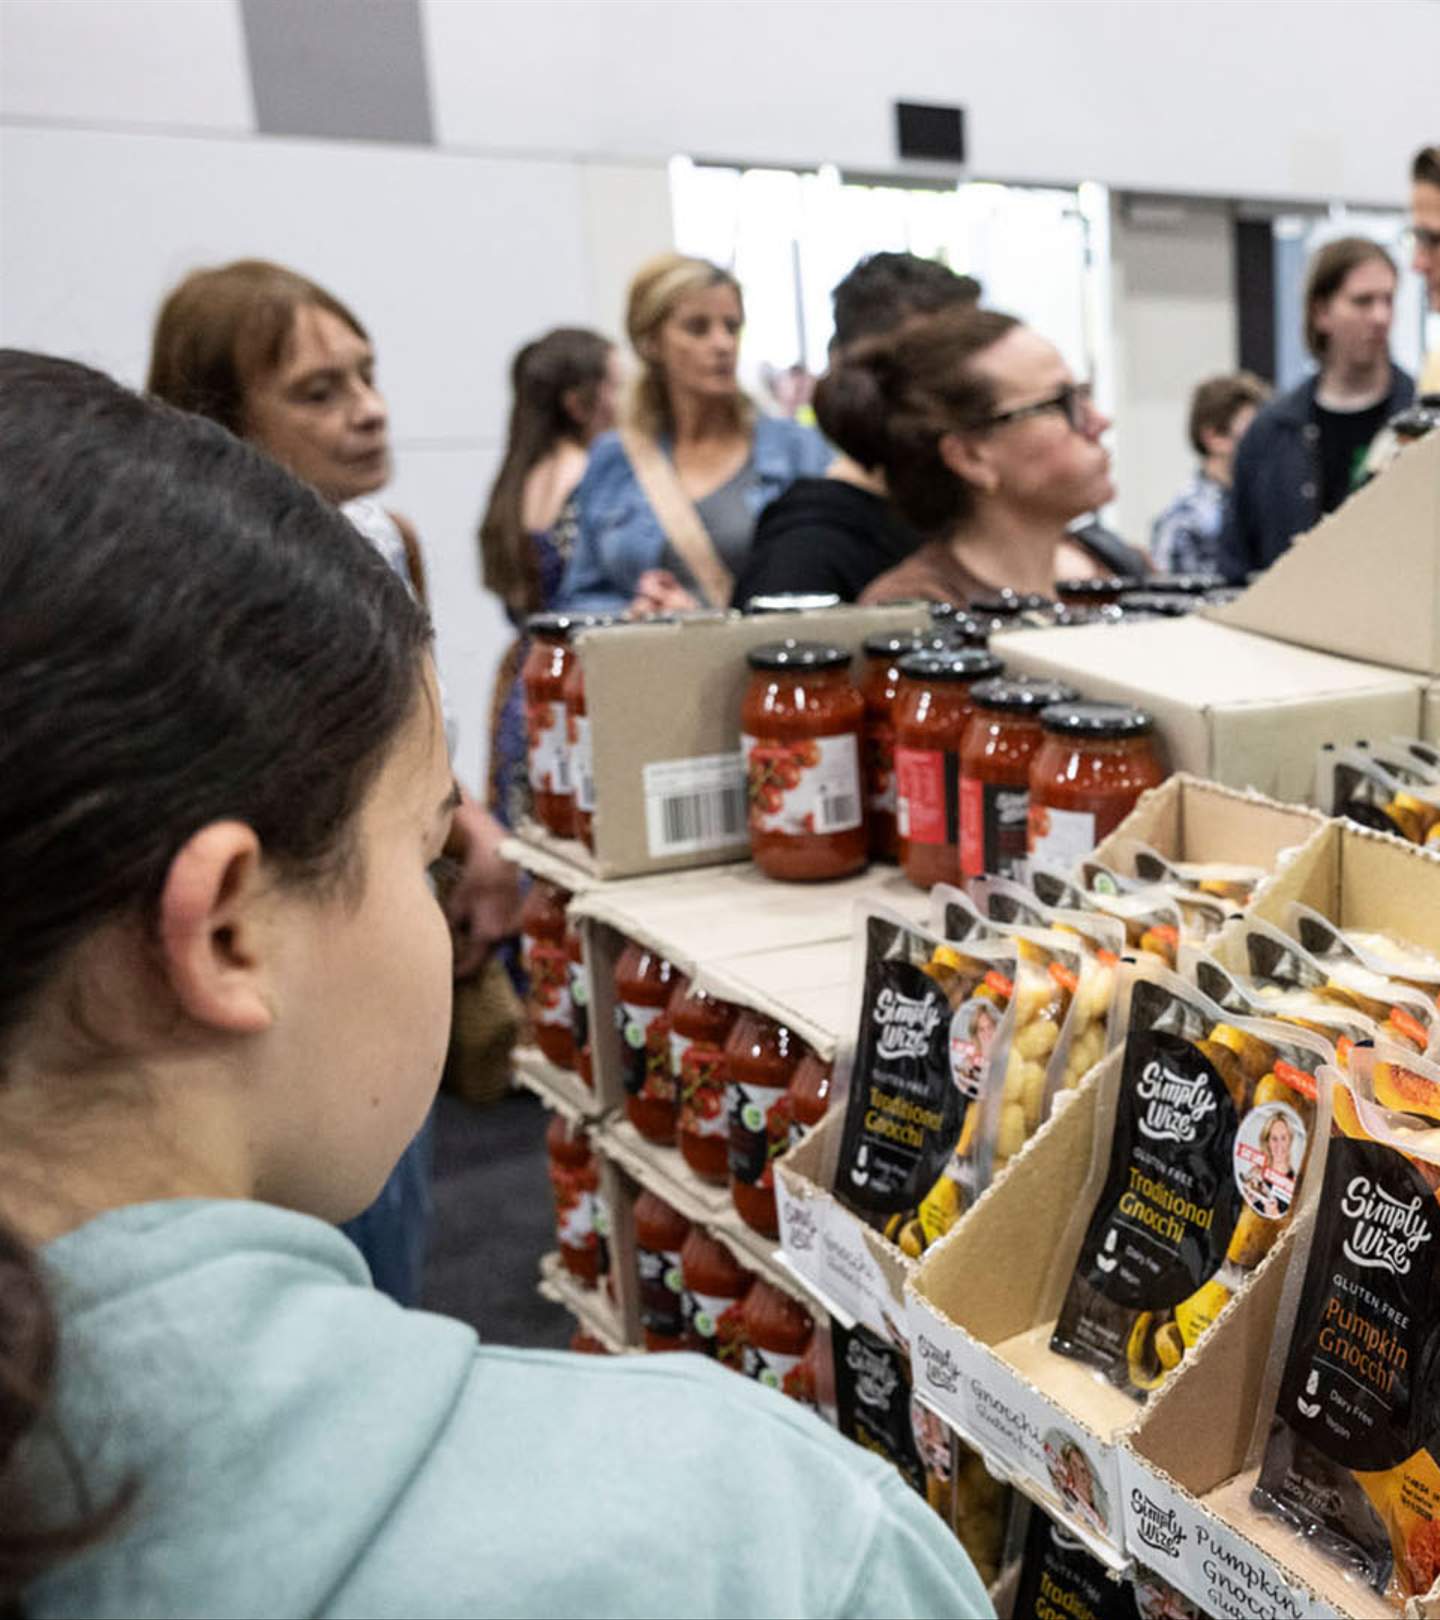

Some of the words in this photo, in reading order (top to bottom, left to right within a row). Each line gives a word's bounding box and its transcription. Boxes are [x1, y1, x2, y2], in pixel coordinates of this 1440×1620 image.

[872, 986, 943, 1037] Simply
[876, 1023, 930, 1061] Wize
[1136, 1061, 1217, 1122] Simply
[863, 1109, 926, 1149] Gnocchi
[1138, 1102, 1197, 1143] Wize
[1128, 1166, 1215, 1231] Traditional
[1167, 1163, 1195, 1190] FREE
[1118, 1192, 1187, 1245] Gnocchi
[1340, 1175, 1432, 1246] Simply
[1342, 1218, 1412, 1276] Wize
[1332, 1272, 1381, 1312] GLUTEN
[1380, 1303, 1410, 1331] FREE
[1318, 1327, 1396, 1395] Gnocchi
[1324, 1296, 1409, 1372] Pumpkin
[1329, 1387, 1353, 1418] Dairy
[1352, 1401, 1375, 1428] Free
[1130, 1488, 1188, 1543] Simply
[1136, 1517, 1181, 1559] Wize
[1195, 1524, 1303, 1619] Pumpkin
